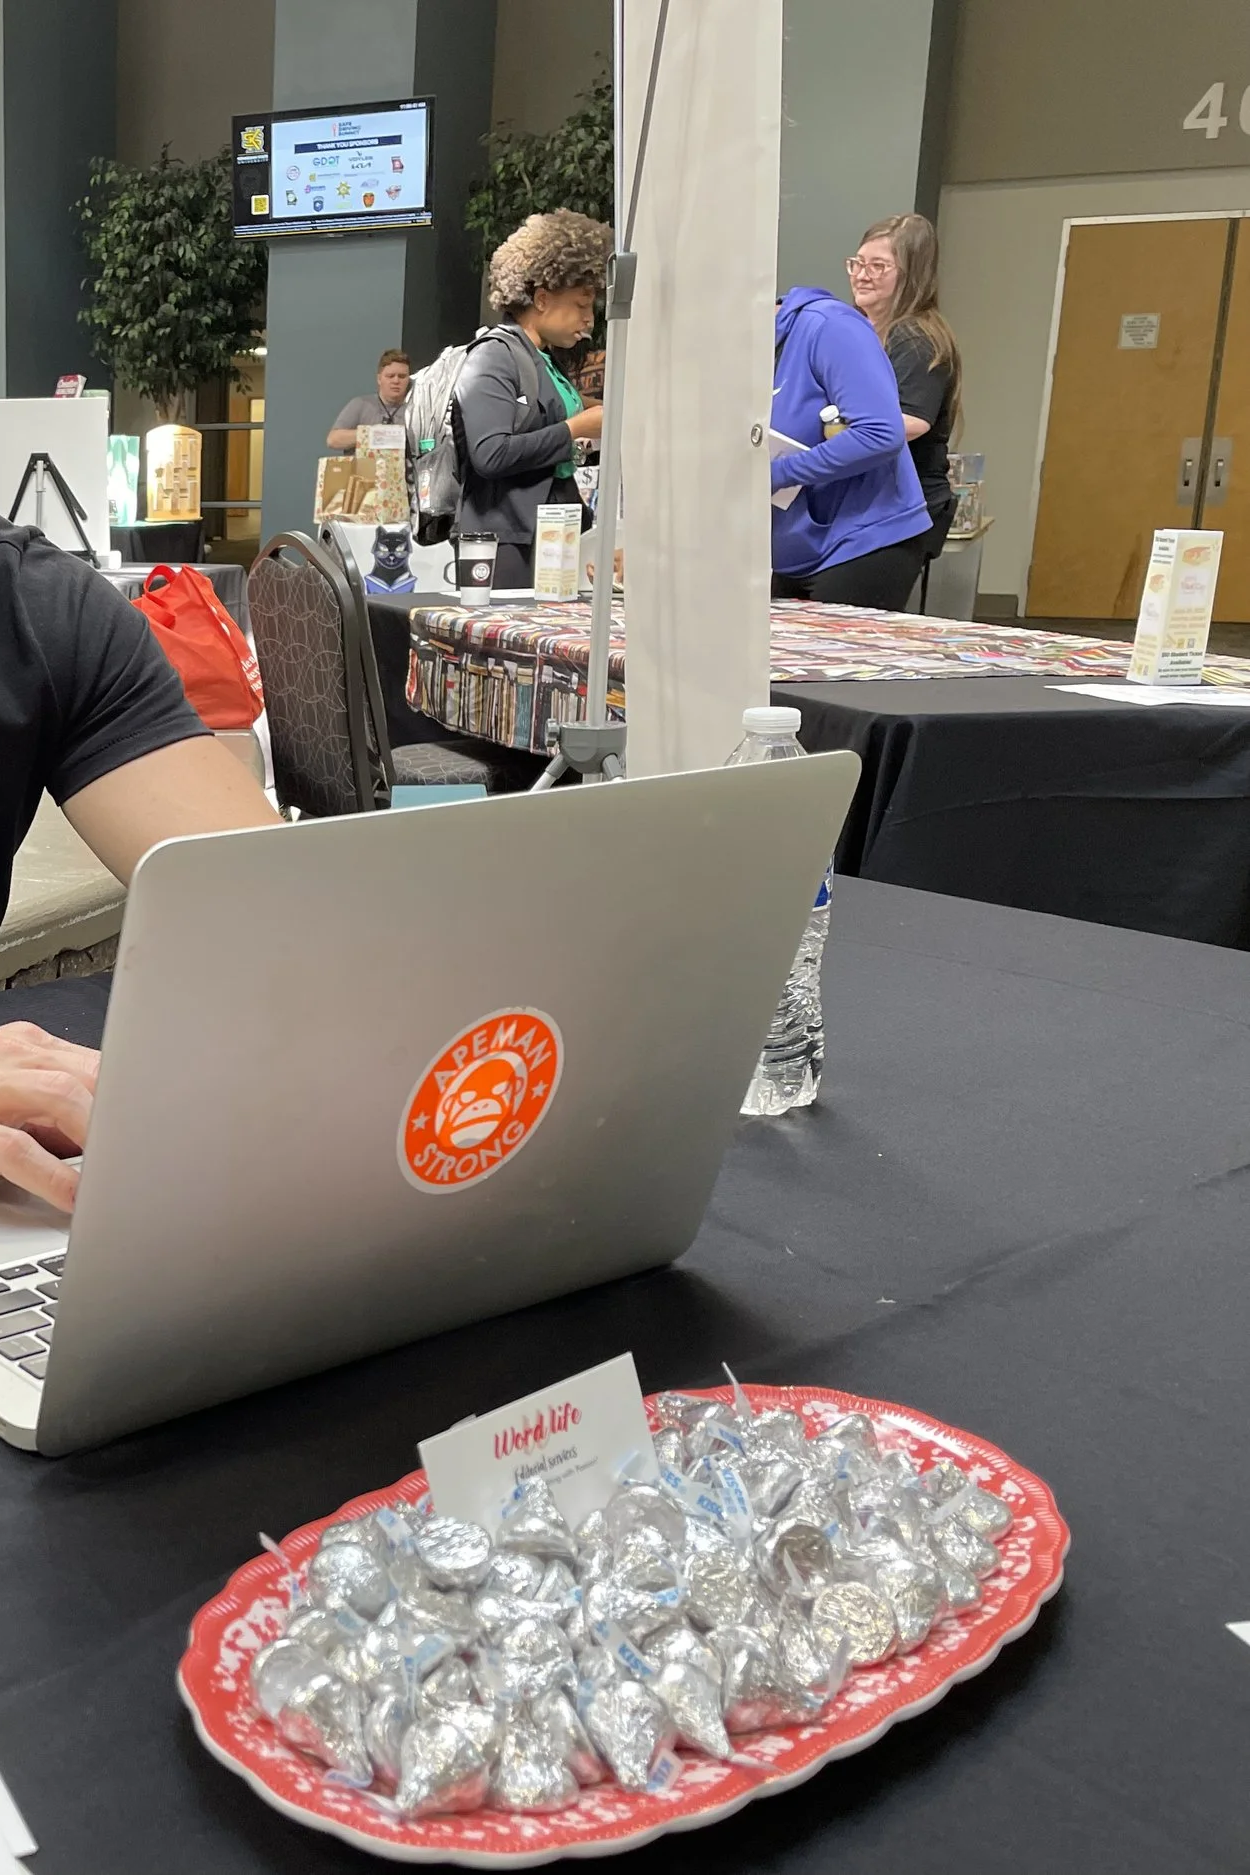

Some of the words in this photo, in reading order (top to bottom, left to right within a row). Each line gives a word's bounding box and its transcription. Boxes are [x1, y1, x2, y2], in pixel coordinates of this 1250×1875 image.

[1182, 82, 1250, 139] 4
[433, 1019, 552, 1094] APEMAN
[414, 1120, 525, 1181] STRONG
[494, 1411, 548, 1459] Word
[549, 1402, 582, 1434] life
[548, 1445, 578, 1468] services
